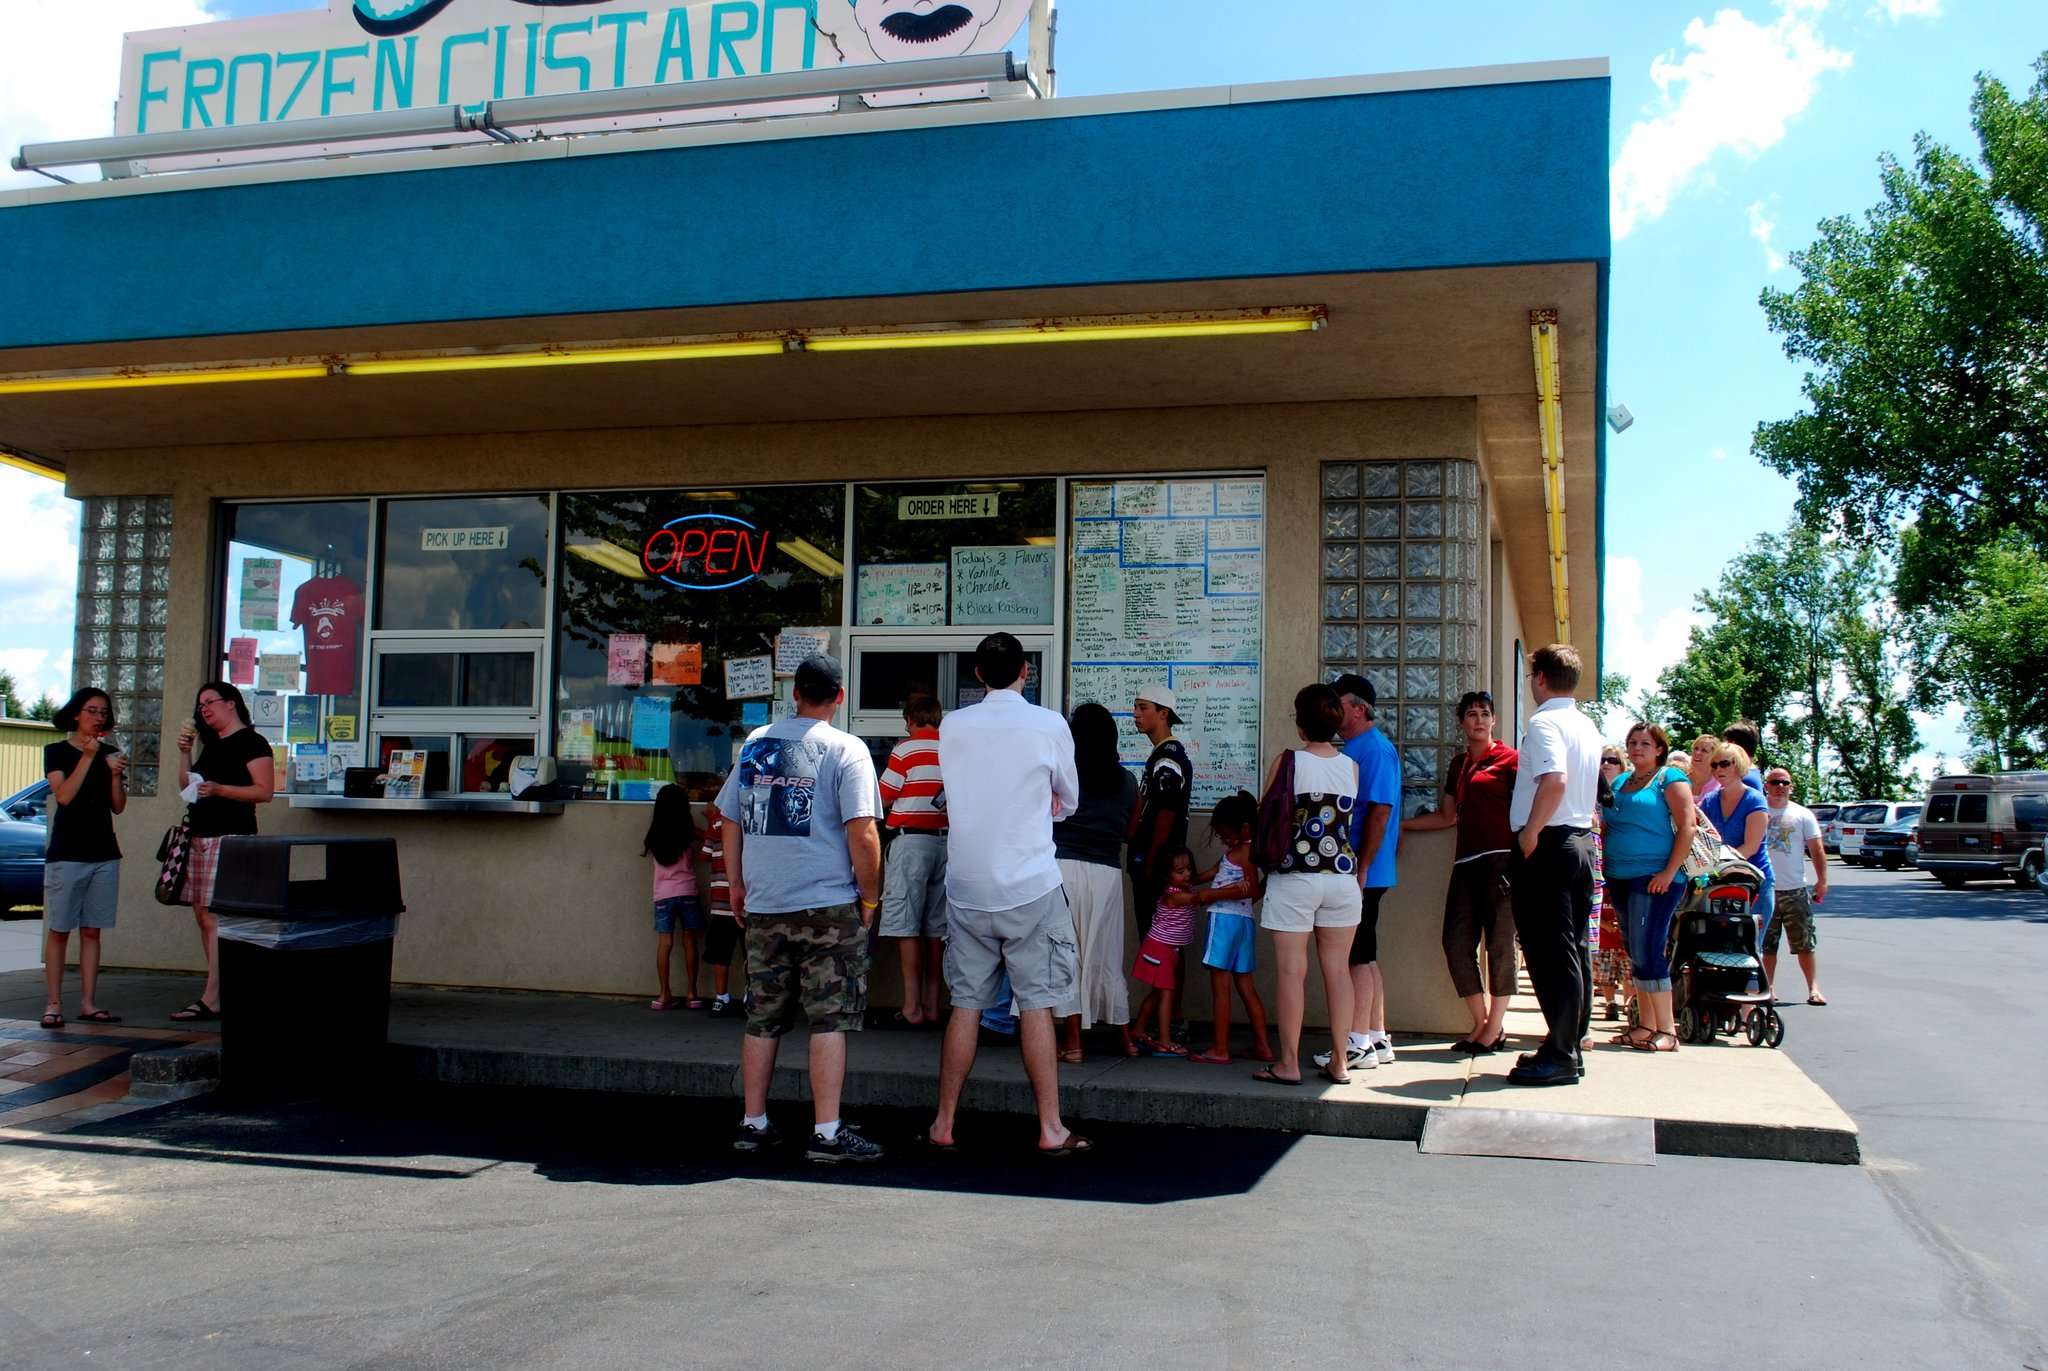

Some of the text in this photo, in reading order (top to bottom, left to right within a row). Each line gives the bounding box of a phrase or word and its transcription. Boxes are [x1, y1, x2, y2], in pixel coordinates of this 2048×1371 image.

[137, 0, 819, 134] FROZEN CUSTARD
[908, 498, 977, 516] ORDER HERE
[426, 531, 494, 547] PICK UP HERE
[643, 529, 769, 574] OPEN
[954, 549, 1049, 567] Today's 3 Flavors
[968, 564, 1002, 580] Vanilla
[965, 577, 1011, 595] Chocolate
[754, 774, 816, 788] BEARS
